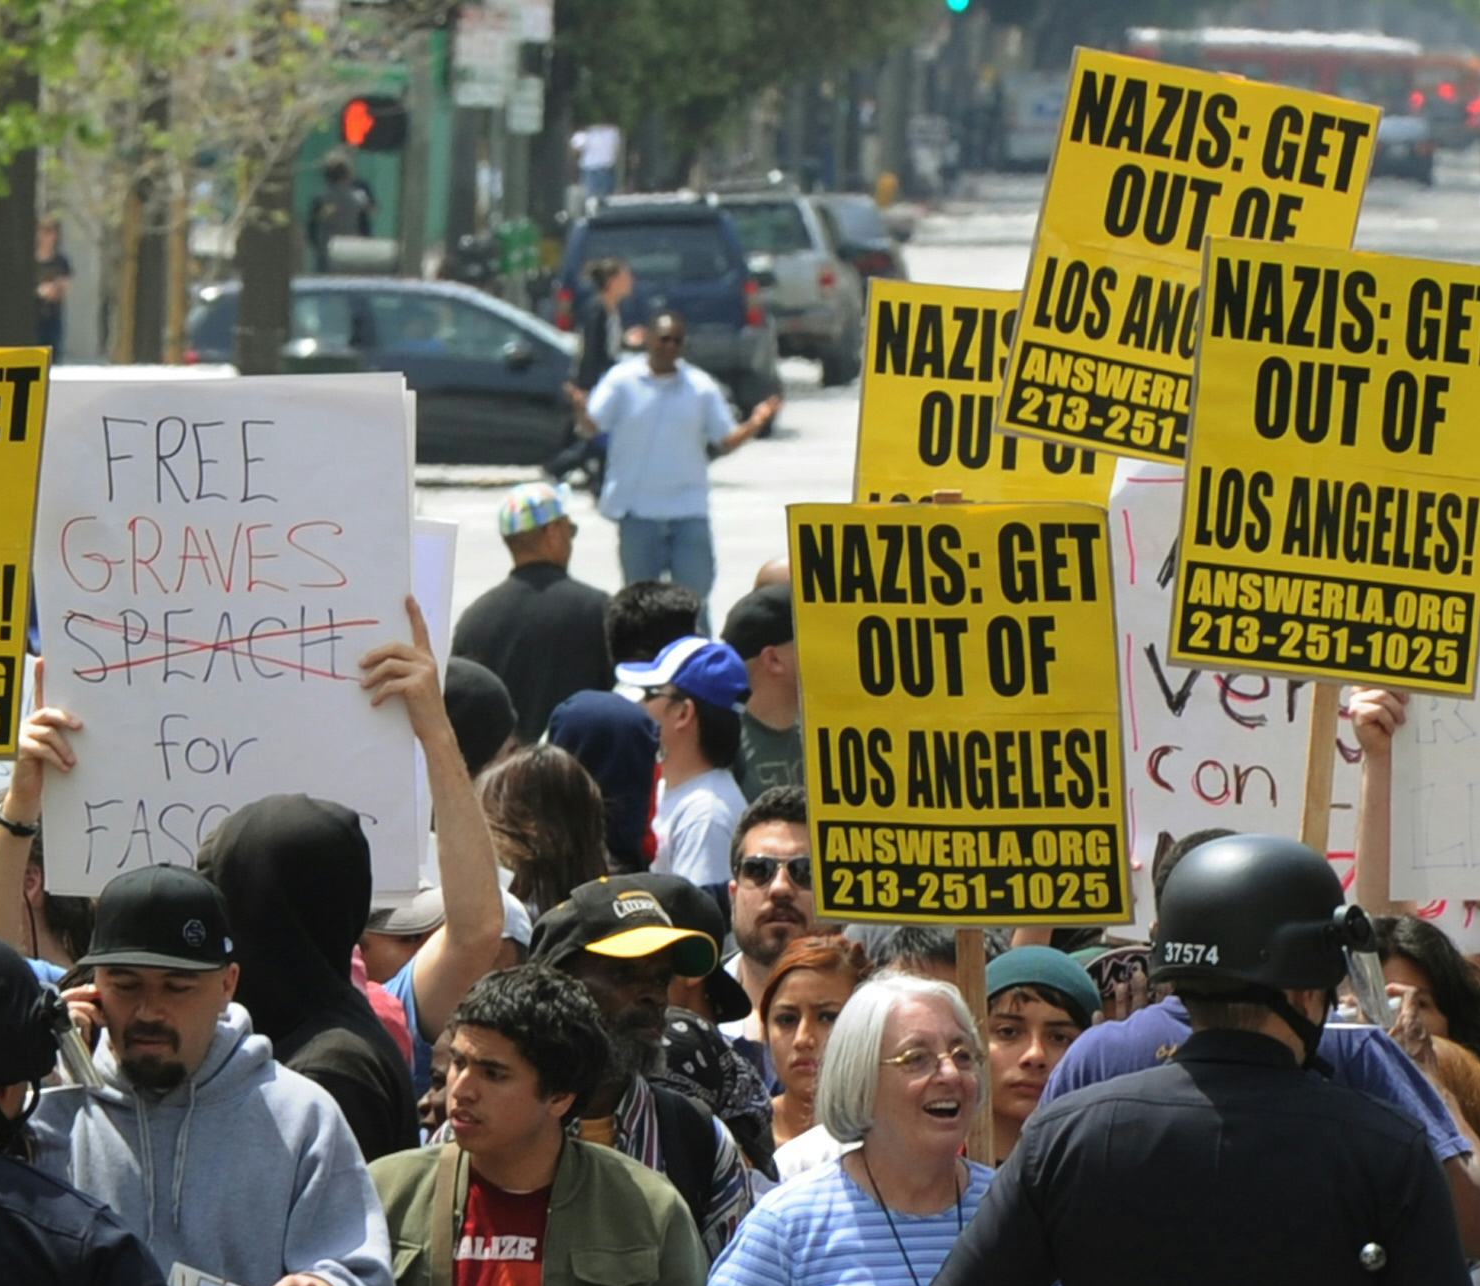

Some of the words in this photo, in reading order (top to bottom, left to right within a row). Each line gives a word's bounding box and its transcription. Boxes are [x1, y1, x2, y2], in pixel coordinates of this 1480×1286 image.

[1070, 69, 1251, 171] NAZIS:
[1263, 105, 1370, 193] GET
[1103, 163, 1222, 251] OUT
[1033, 257, 1117, 340] LOS
[1211, 258, 1389, 355] NAZIS:
[875, 301, 1016, 379] NAZI
[1018, 389, 1186, 450] 213-251-
[1021, 350, 1190, 412] ANSWERL
[1254, 356, 1370, 446] OUT
[1384, 369, 1449, 457] OF
[102, 415, 278, 504] FREE
[60, 516, 348, 595] GRAVES
[1193, 466, 1274, 554] LOS
[1282, 476, 1480, 577] ANGELES!
[798, 524, 983, 605] NAZIS:
[997, 522, 1102, 603] GET
[1188, 565, 1466, 635] ANSWERLA.ORG
[64, 605, 344, 687] SPEACH
[857, 616, 969, 698] OUT
[988, 616, 1056, 696] OF
[1188, 612, 1459, 676] 213-251-1025
[154, 714, 259, 781] for
[818, 727, 896, 808] LOS
[907, 727, 1110, 809] ANGELES!
[825, 827, 1111, 870] ANSWERLA.ORG
[831, 869, 1110, 911] 213-251-1025
[1164, 942, 1219, 965] 37574
[453, 1235, 537, 1261] ALIZE
